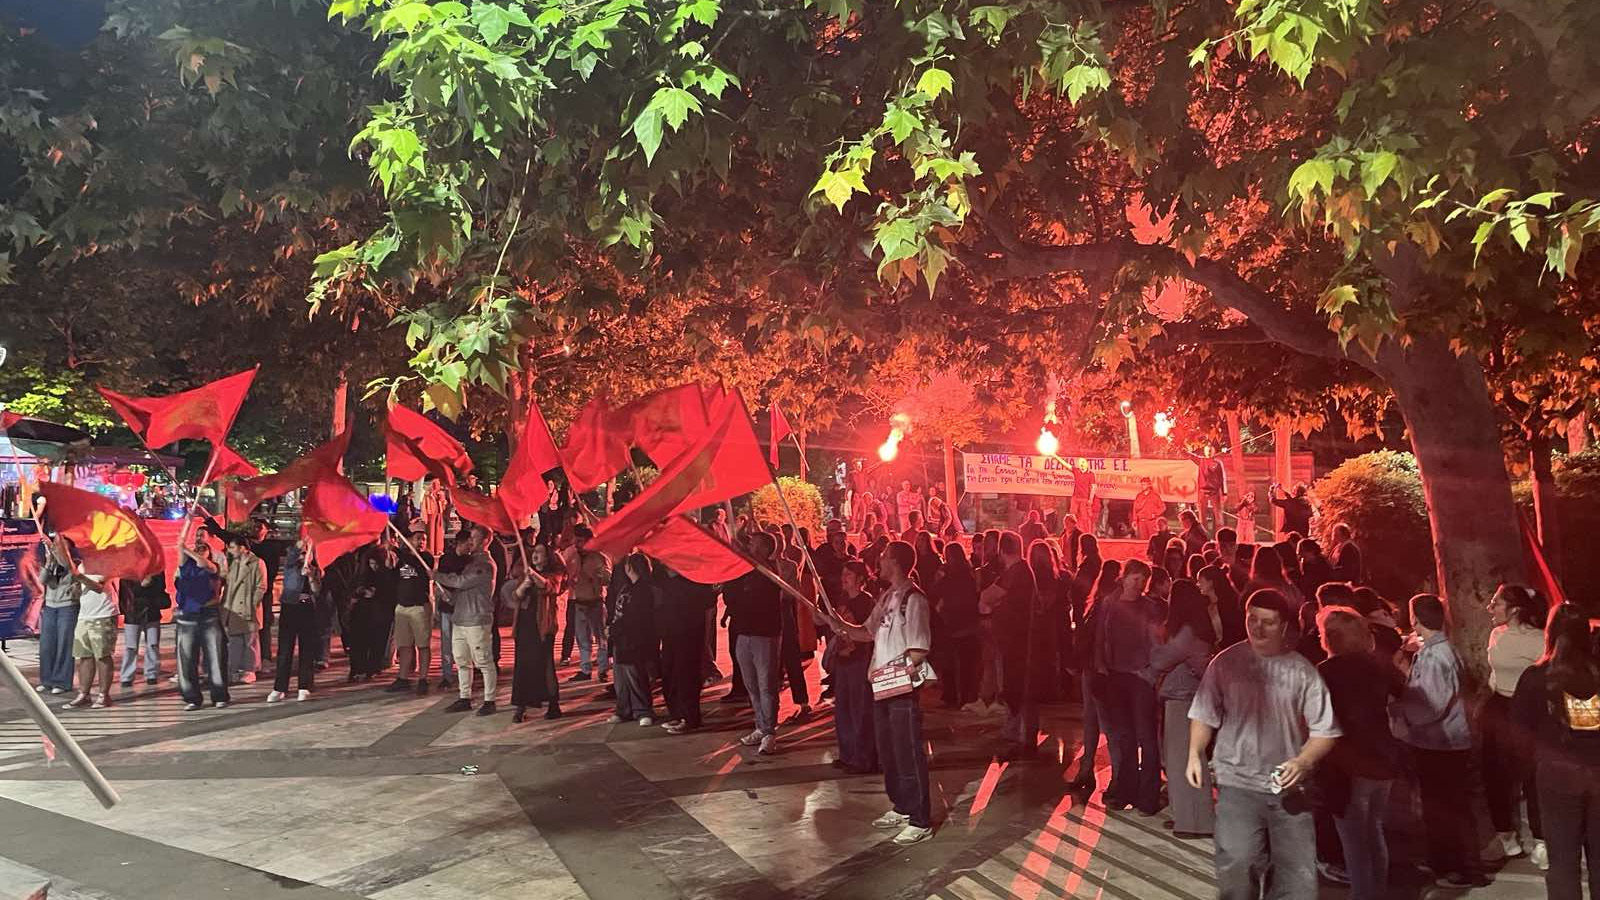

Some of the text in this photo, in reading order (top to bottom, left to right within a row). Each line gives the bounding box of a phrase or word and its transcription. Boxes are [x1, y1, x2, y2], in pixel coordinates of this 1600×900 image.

[981, 454, 1012, 466] ΣΠΑΜΕ
[1019, 456, 1032, 468] ΤΑ
[1088, 459, 1106, 470] ΤΗΣ
[1113, 459, 1132, 472] Ε.Ε.
